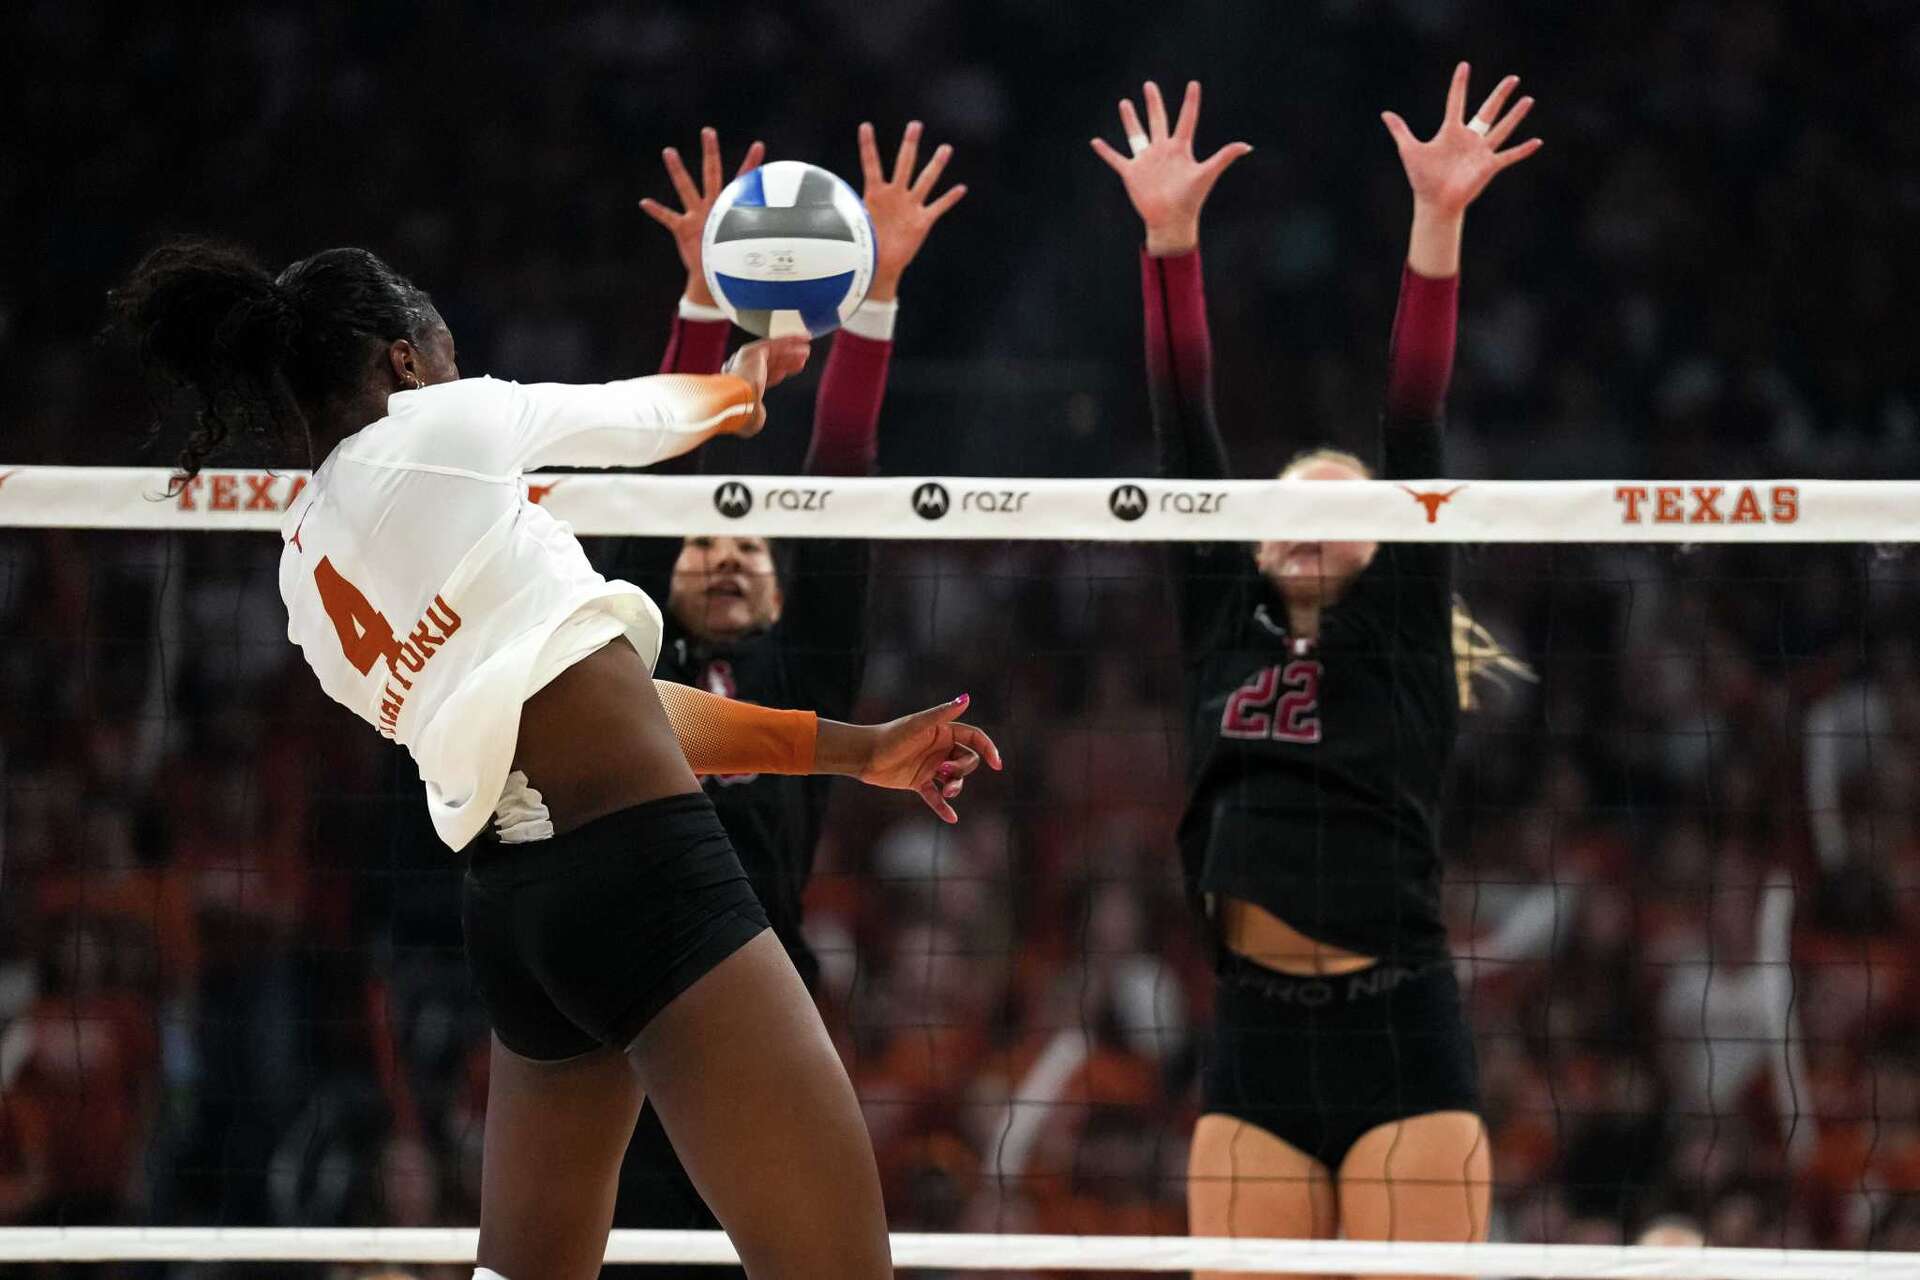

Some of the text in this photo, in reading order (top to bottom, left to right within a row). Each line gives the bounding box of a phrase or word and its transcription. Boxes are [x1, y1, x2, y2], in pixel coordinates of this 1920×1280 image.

[765, 489, 833, 511] razr
[961, 490, 1030, 513] razr
[1159, 492, 1229, 514] razr
[1614, 486, 1799, 524] TEXAS
[313, 555, 402, 677] 4
[1220, 660, 1324, 743] 22
